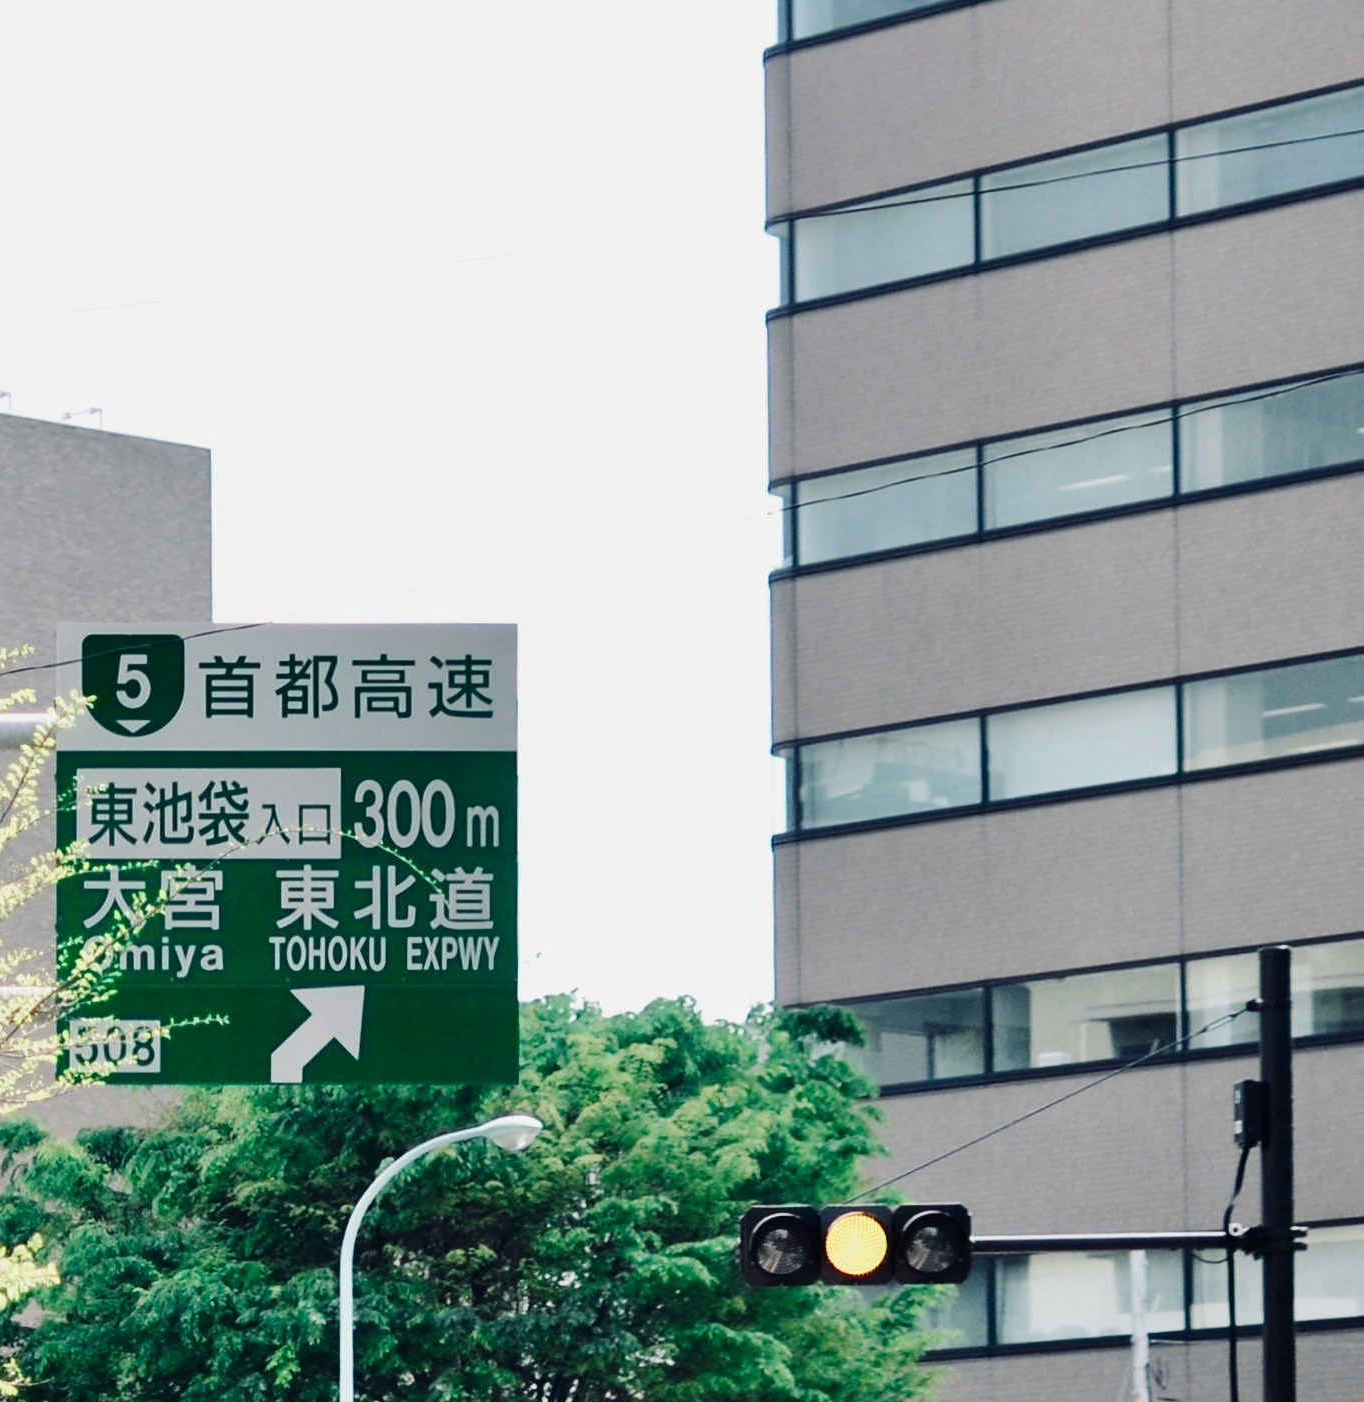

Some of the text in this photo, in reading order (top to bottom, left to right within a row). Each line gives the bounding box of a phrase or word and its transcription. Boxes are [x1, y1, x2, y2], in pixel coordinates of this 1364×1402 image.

[115, 653, 152, 709] 5
[198, 653, 494, 719] 首都高速
[88, 780, 333, 847] 東池袋入口
[83, 864, 494, 931] 大宮 東北道
[270, 936, 386, 972] TOHOKU
[407, 936, 500, 971] EXPWY
